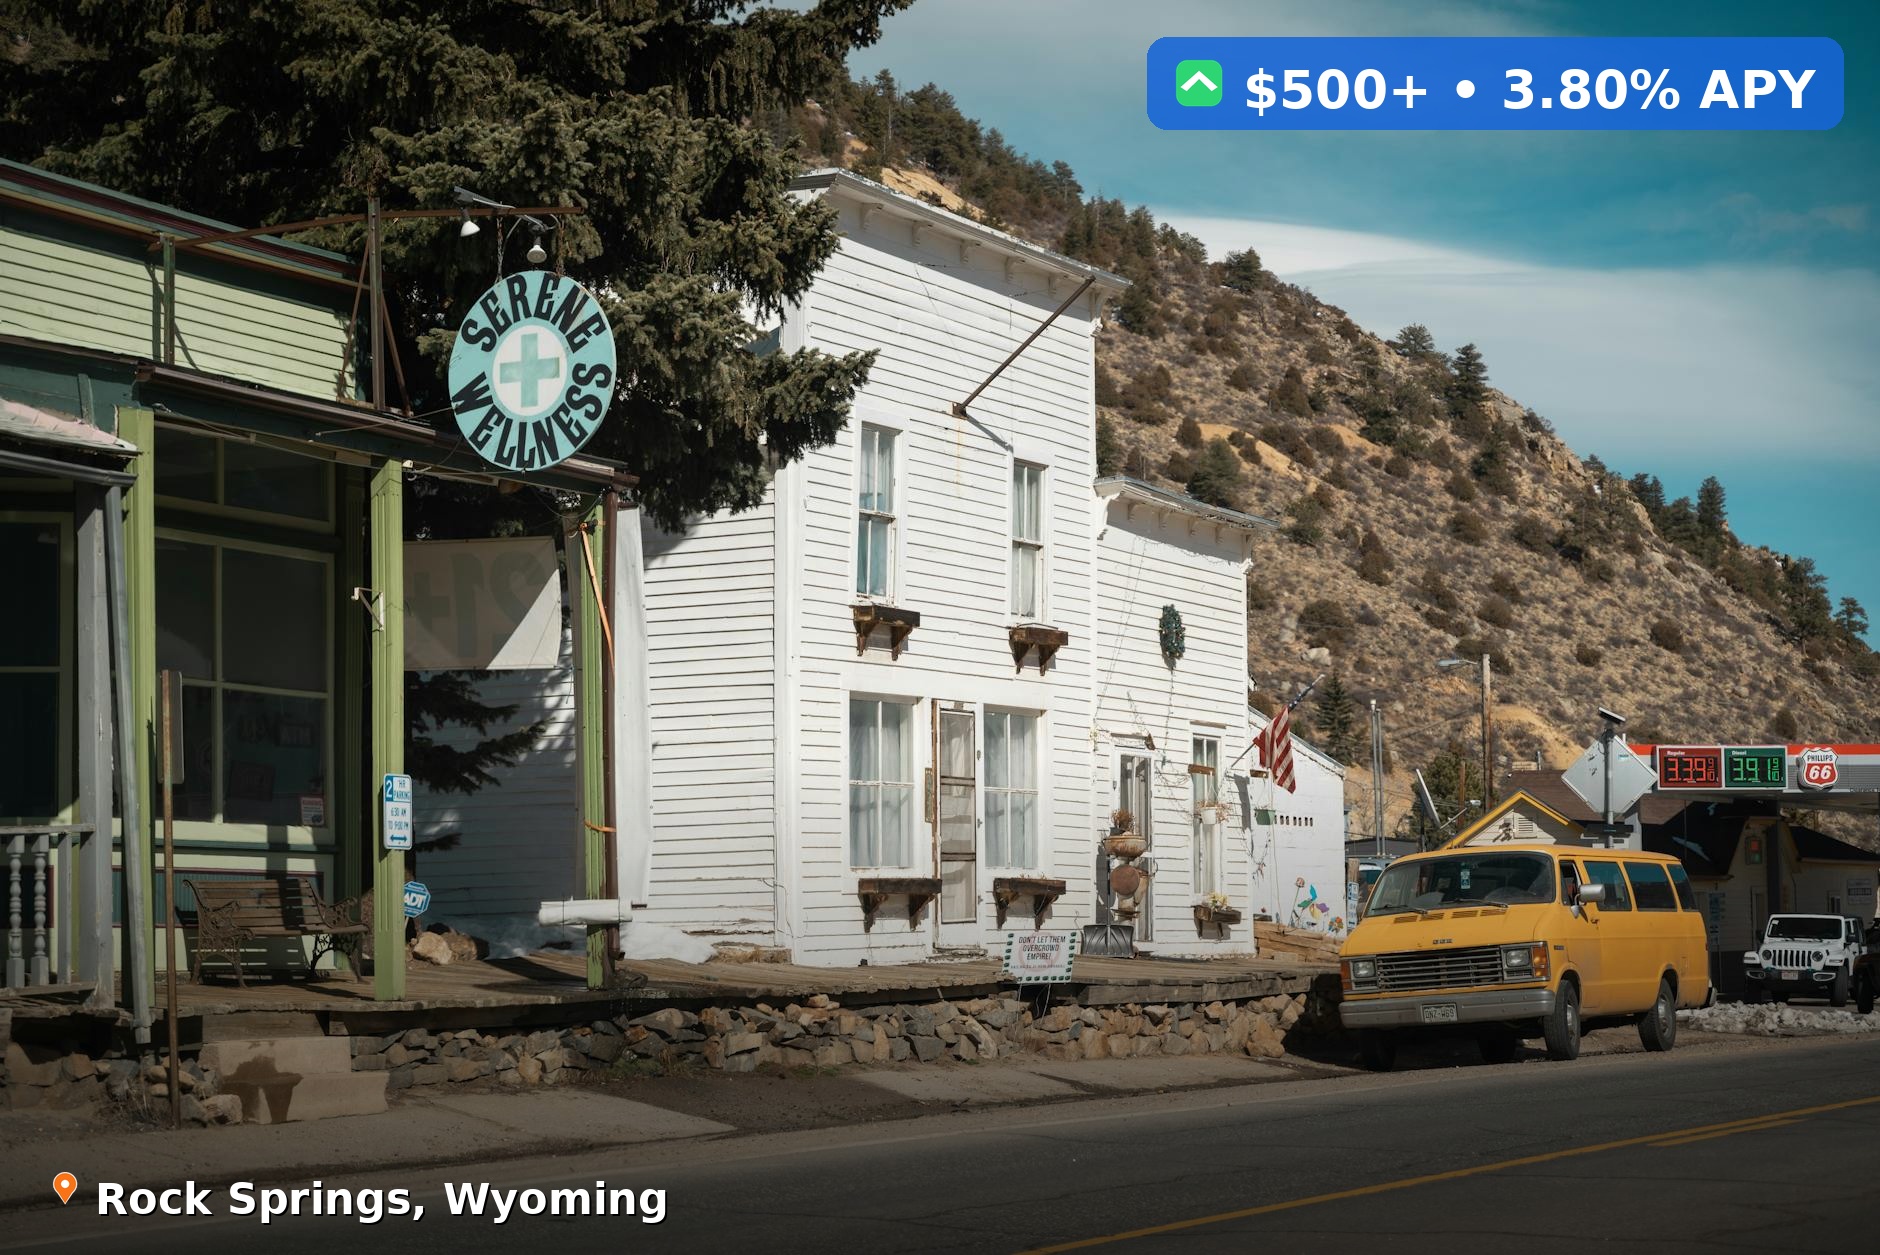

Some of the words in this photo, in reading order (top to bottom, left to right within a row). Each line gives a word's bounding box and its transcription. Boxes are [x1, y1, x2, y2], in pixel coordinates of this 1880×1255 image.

[461, 272, 607, 353] SERENE
[451, 363, 613, 469] WELLNESS
[1807, 754, 1833, 762] PHILLIPS
[1809, 765, 1832, 780] 66
[386, 780, 393, 798] 2
[398, 780, 406, 788] HR
[394, 790, 411, 801] PARKING
[404, 892, 426, 908] ADT
[1022, 944, 1060, 952] OVERCROWD
